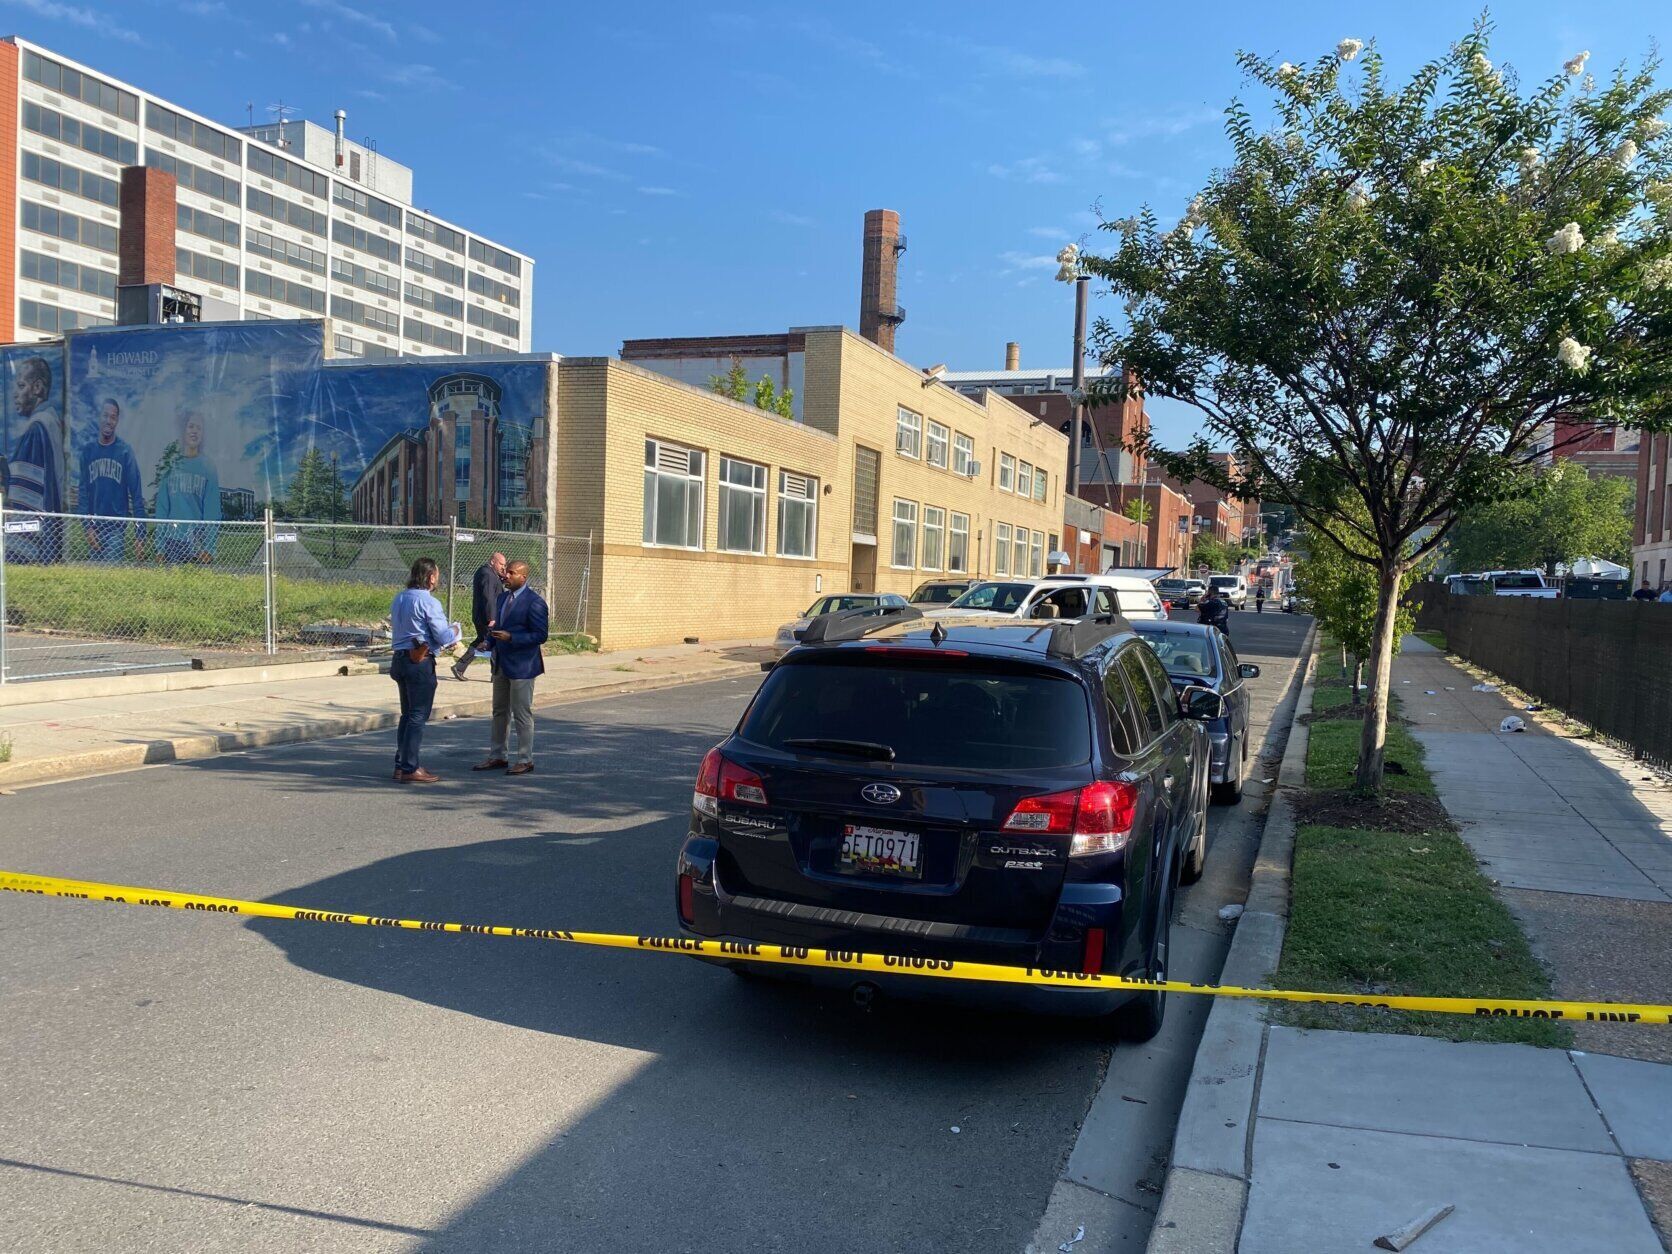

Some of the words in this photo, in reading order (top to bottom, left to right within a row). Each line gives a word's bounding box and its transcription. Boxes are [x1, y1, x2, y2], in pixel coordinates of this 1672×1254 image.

[107, 351, 159, 365] HOWARD
[88, 458, 122, 484] HOWARD
[725, 815, 775, 829] SUBARU
[990, 846, 1056, 857] OUTBACK
[638, 936, 703, 950] POLICE
[720, 941, 760, 955] LINE
